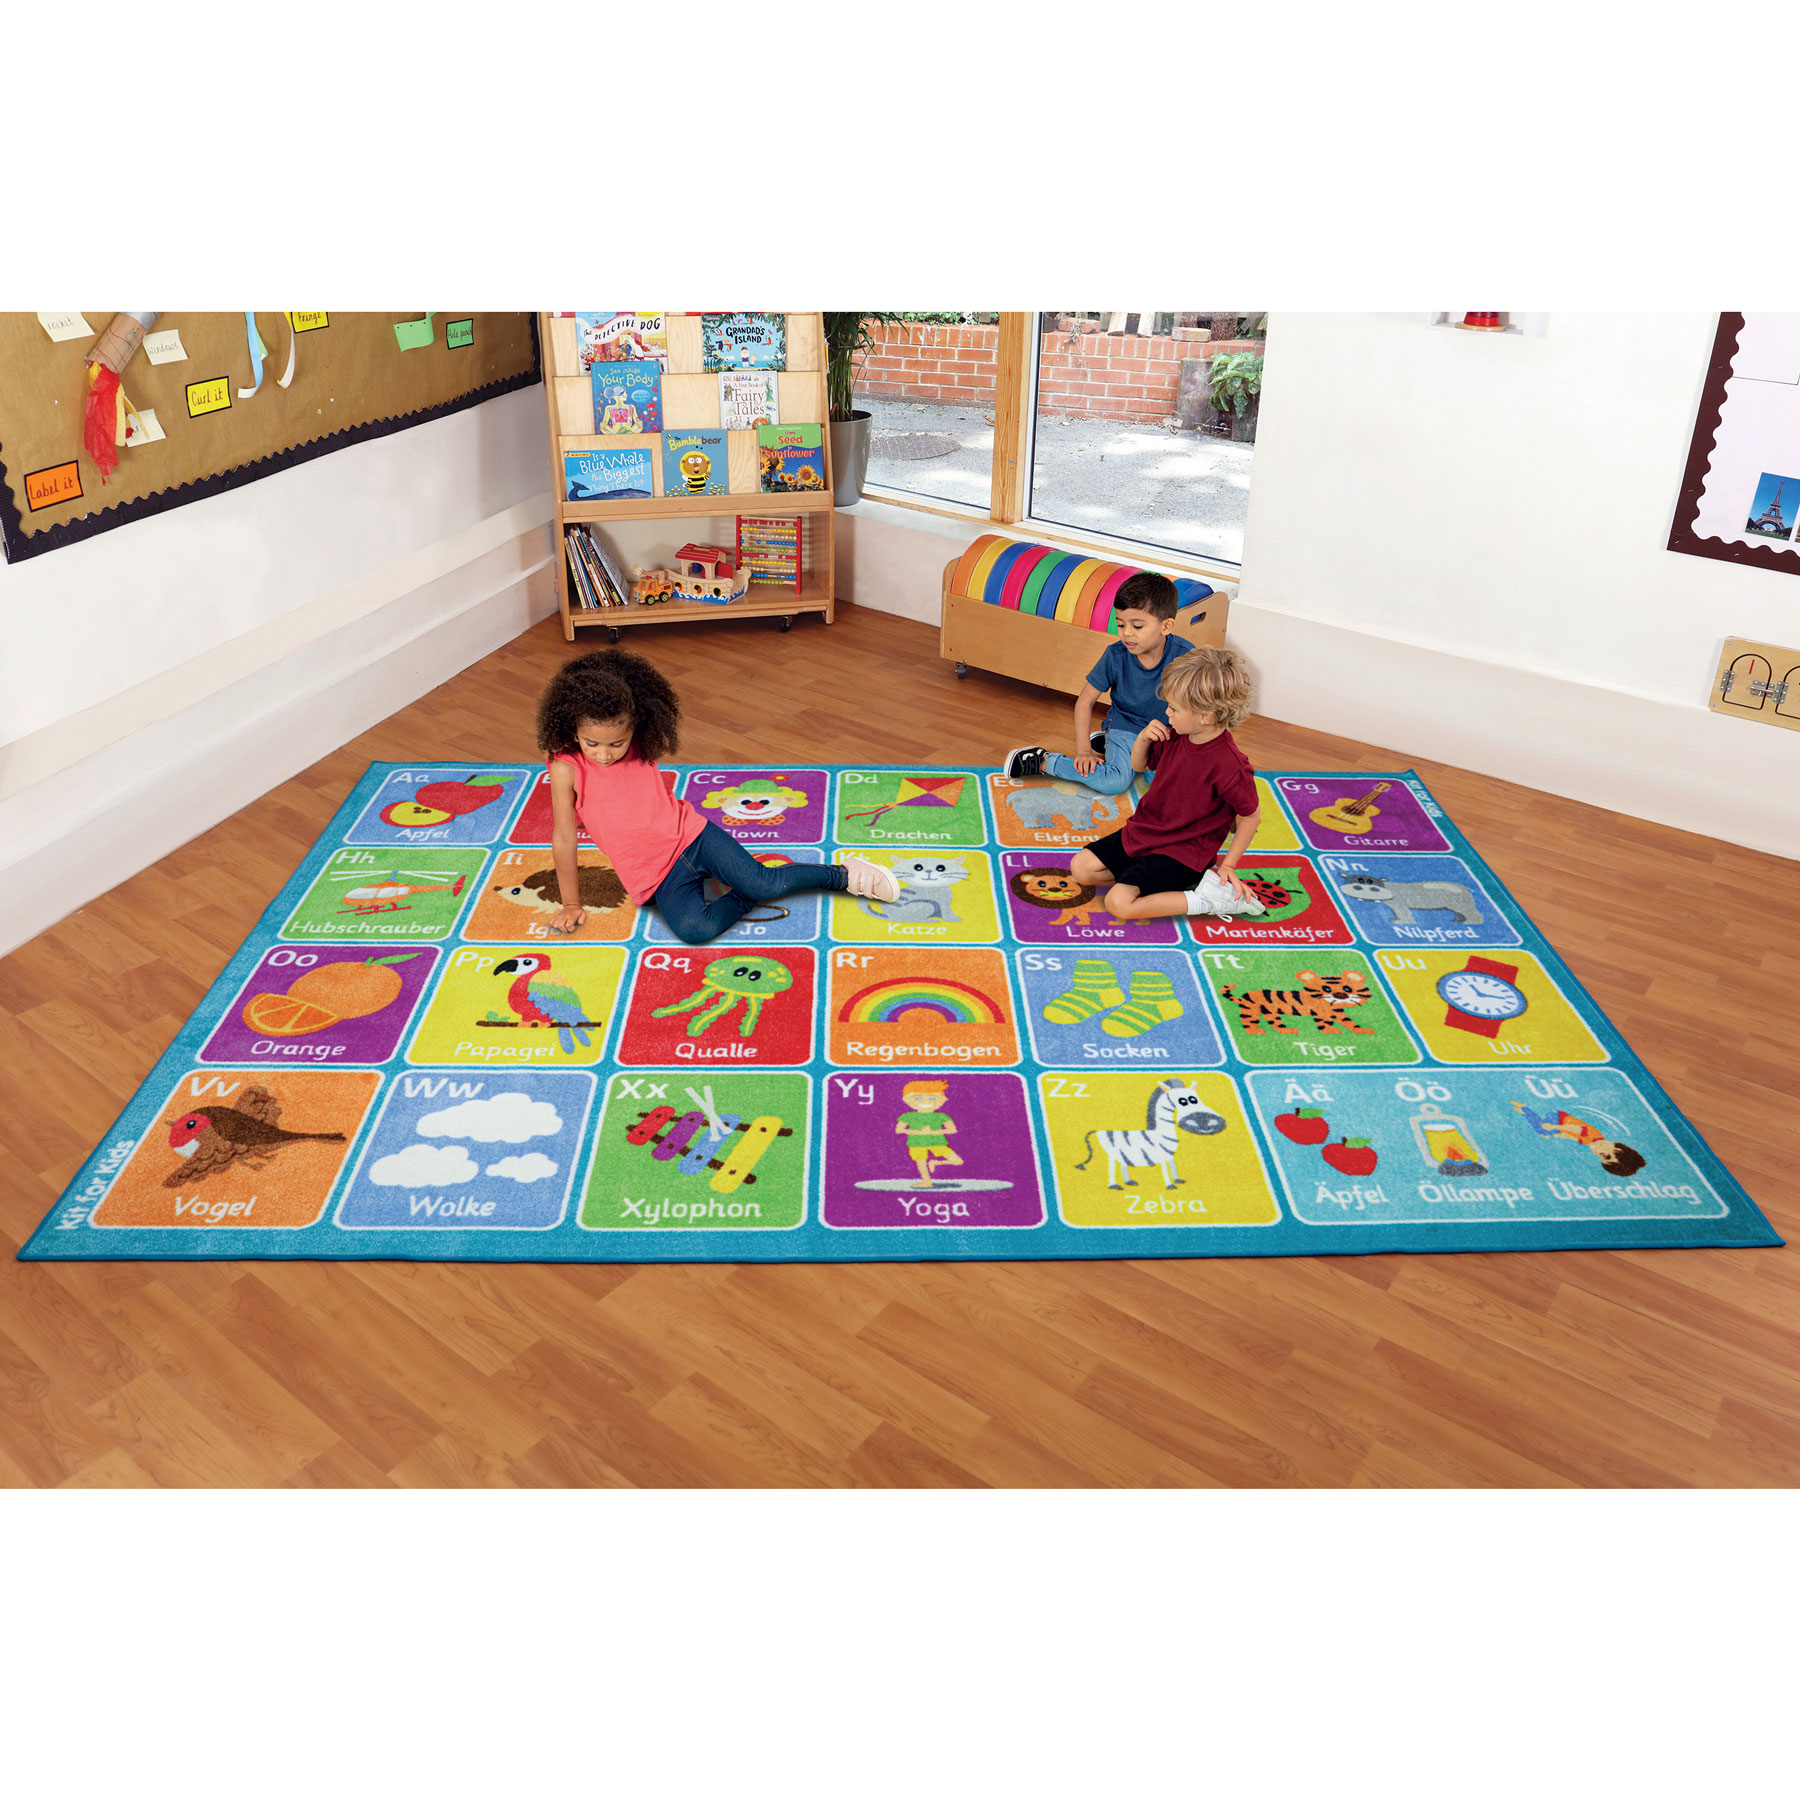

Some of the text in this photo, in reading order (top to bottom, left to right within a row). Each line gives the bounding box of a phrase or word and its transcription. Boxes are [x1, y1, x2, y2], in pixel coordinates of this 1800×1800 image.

[594, 318, 636, 341] DETECTIVE
[640, 317, 661, 331] DOG
[725, 326, 766, 338] GRANDAD'S
[734, 335, 762, 345] ISLAND
[597, 372, 654, 387] Your Body
[609, 367, 621, 375] See
[191, 387, 223, 407] Curl it
[734, 388, 765, 406] Fairy
[733, 401, 765, 416] Tales
[668, 435, 722, 451] Bumblebear
[777, 435, 803, 444] Seed
[579, 451, 646, 474] Blue Whale
[603, 462, 645, 483] Biggest
[29, 476, 74, 500] Label it
[392, 771, 430, 784] Aa
[693, 772, 726, 785] Cc
[844, 773, 879, 785] Dd
[993, 776, 1025, 787] Ee
[1282, 779, 1320, 794] Gg
[395, 828, 450, 842] Apfel
[870, 828, 952, 840] Drachen
[1343, 835, 1409, 846] Gitarre
[335, 851, 375, 865] Hh
[502, 852, 523, 866] Ii
[1005, 854, 1032, 868] Ll
[1325, 858, 1369, 872] Nn
[289, 920, 446, 935] Hubschrauber
[888, 922, 948, 935] Katze
[1066, 925, 1125, 938] Löwe
[1205, 924, 1335, 942] Marienkäfer
[1392, 924, 1479, 941] Nilpferd
[267, 950, 318, 967] Oo
[455, 951, 494, 973] Pp
[643, 952, 692, 974] Qq
[835, 952, 875, 968] Rr
[1025, 953, 1063, 971] Ss
[1205, 953, 1245, 970] Tt
[1381, 954, 1428, 971] Uu
[250, 1040, 347, 1060] Orange
[454, 1041, 556, 1061] Papagei
[675, 1042, 758, 1059] Qualle
[847, 1041, 1002, 1061] Regenbogen
[1082, 1042, 1171, 1059] Socken
[1293, 1041, 1357, 1061] Tiger
[1488, 1040, 1533, 1055] Uhr
[191, 1077, 240, 1098] Vv
[403, 1077, 485, 1099] Ww
[616, 1079, 669, 1099] Xx
[834, 1078, 875, 1105] Yy
[1046, 1078, 1091, 1098] Zz
[1284, 1074, 1579, 1104] Ää Öö Üü
[55, 1140, 135, 1230] Kit for Kids
[1315, 1176, 1702, 1210] Äpfel Öllampe Überschlag
[175, 1195, 258, 1223] Vogel
[409, 1194, 497, 1217] Wolke
[620, 1197, 762, 1225] Xylophon
[898, 1196, 970, 1223] Yoga
[1125, 1194, 1207, 1215] Zebra
